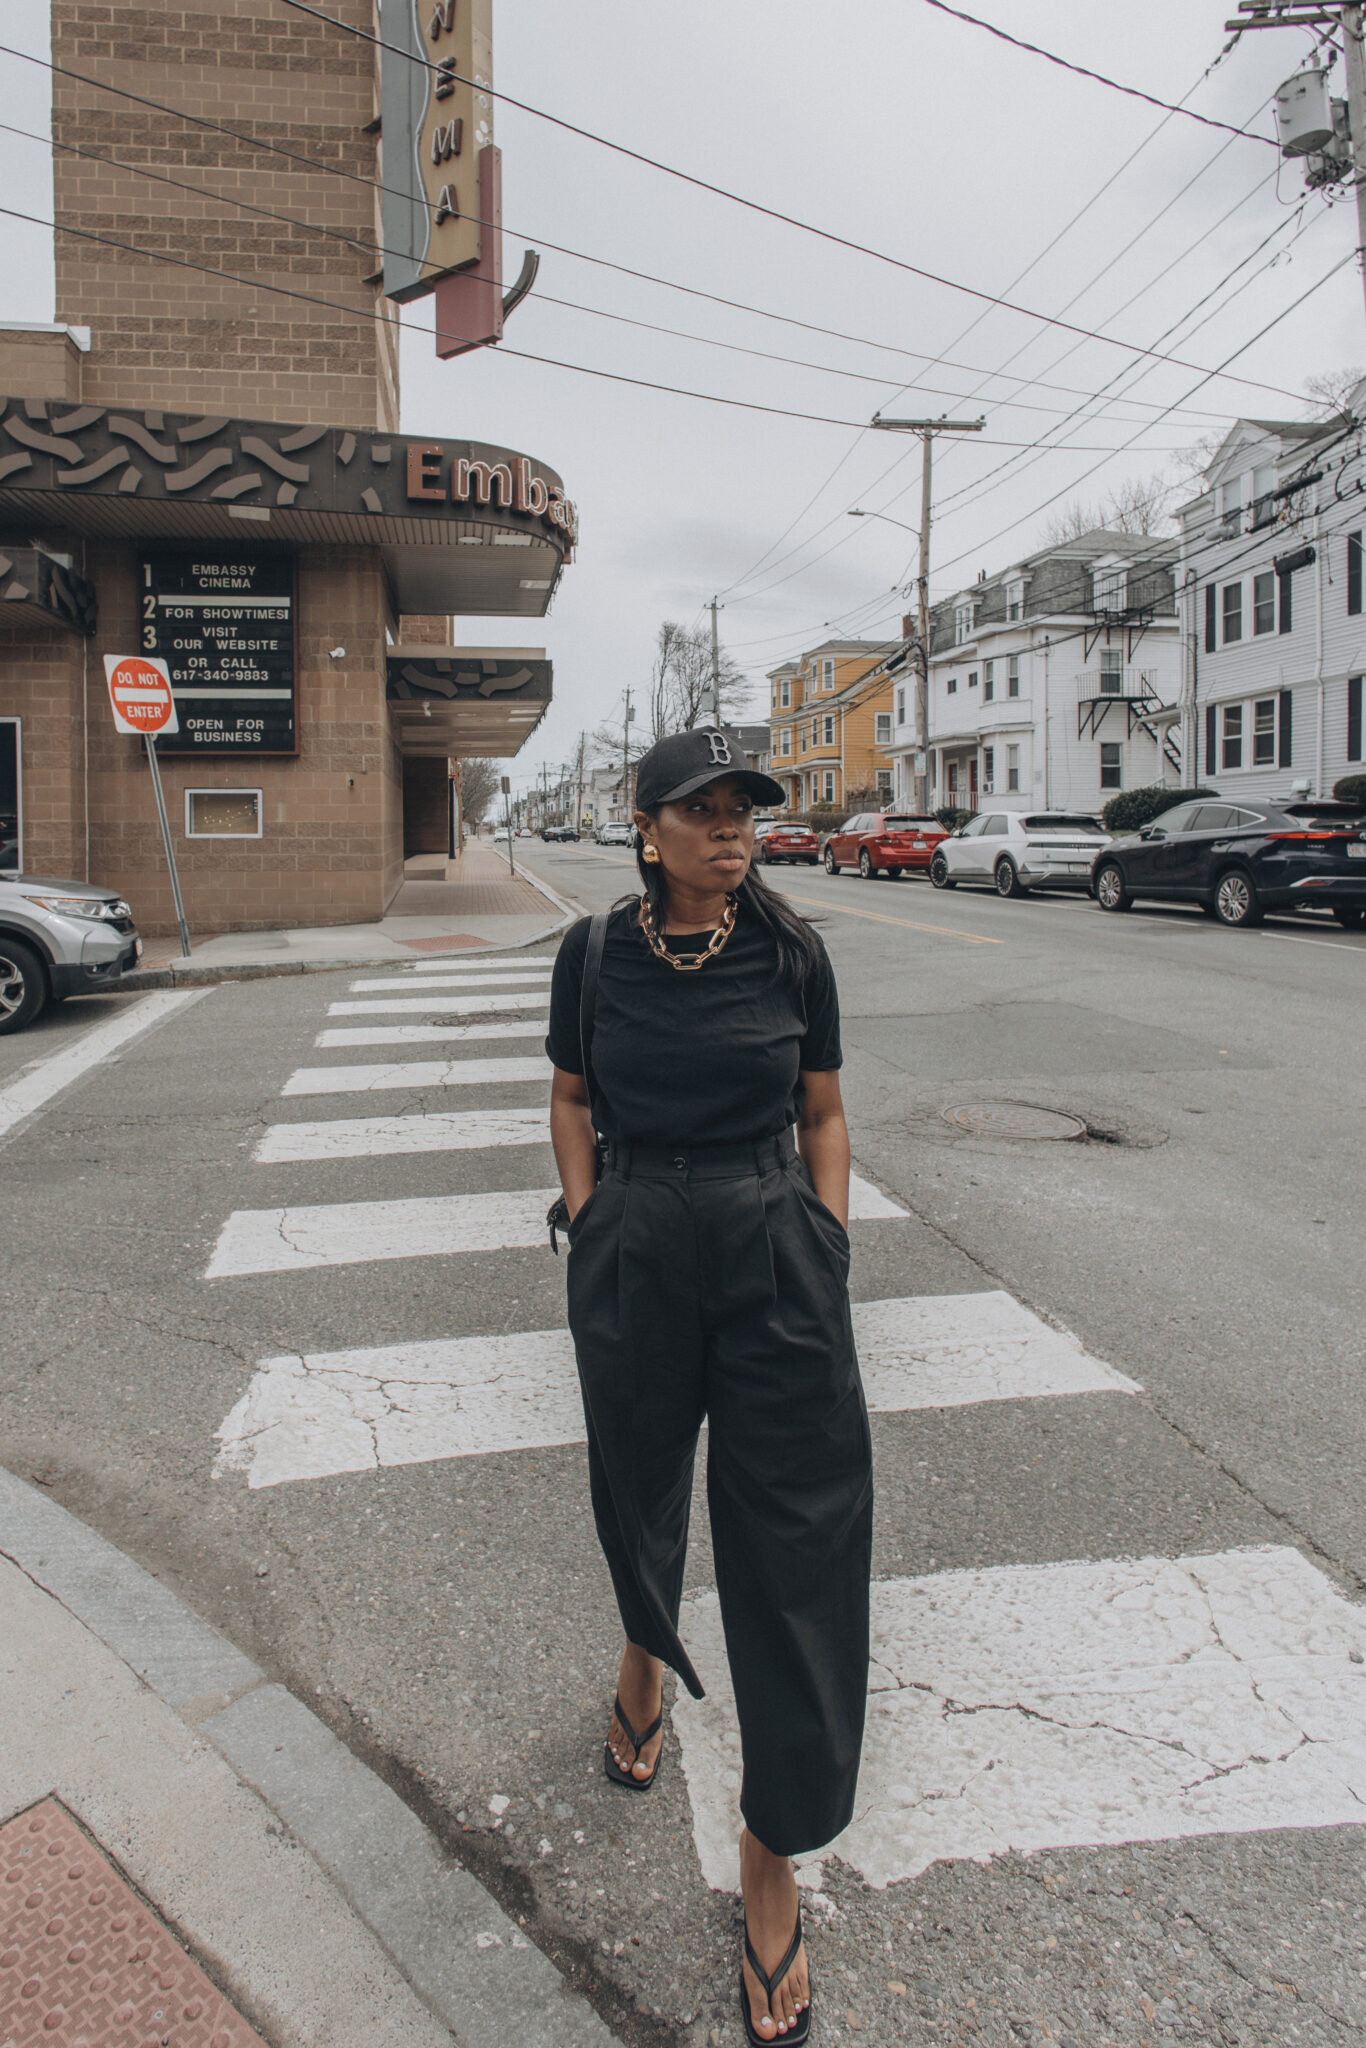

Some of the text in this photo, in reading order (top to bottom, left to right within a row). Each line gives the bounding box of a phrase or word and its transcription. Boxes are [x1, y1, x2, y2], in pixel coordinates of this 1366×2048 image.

[407, 444, 578, 546] Emba
[143, 564, 151, 587] 1
[192, 565, 256, 576] EMBASSY
[199, 578, 251, 588] CINEMA
[143, 595, 156, 619] 2
[165, 608, 194, 618] FOR
[143, 625, 157, 649] 3
[202, 627, 238, 637] VISIT
[173, 639, 278, 650] OUR WEBSITE
[188, 658, 257, 668] OR CALL
[117, 671, 158, 685] DO NOT
[173, 670, 269, 681] 617-340-9883
[127, 705, 162, 718] ENTER
[186, 719, 264, 729] OPEN FOR
[194, 732, 261, 742] BUSINESS
[702, 732, 732, 765] B
